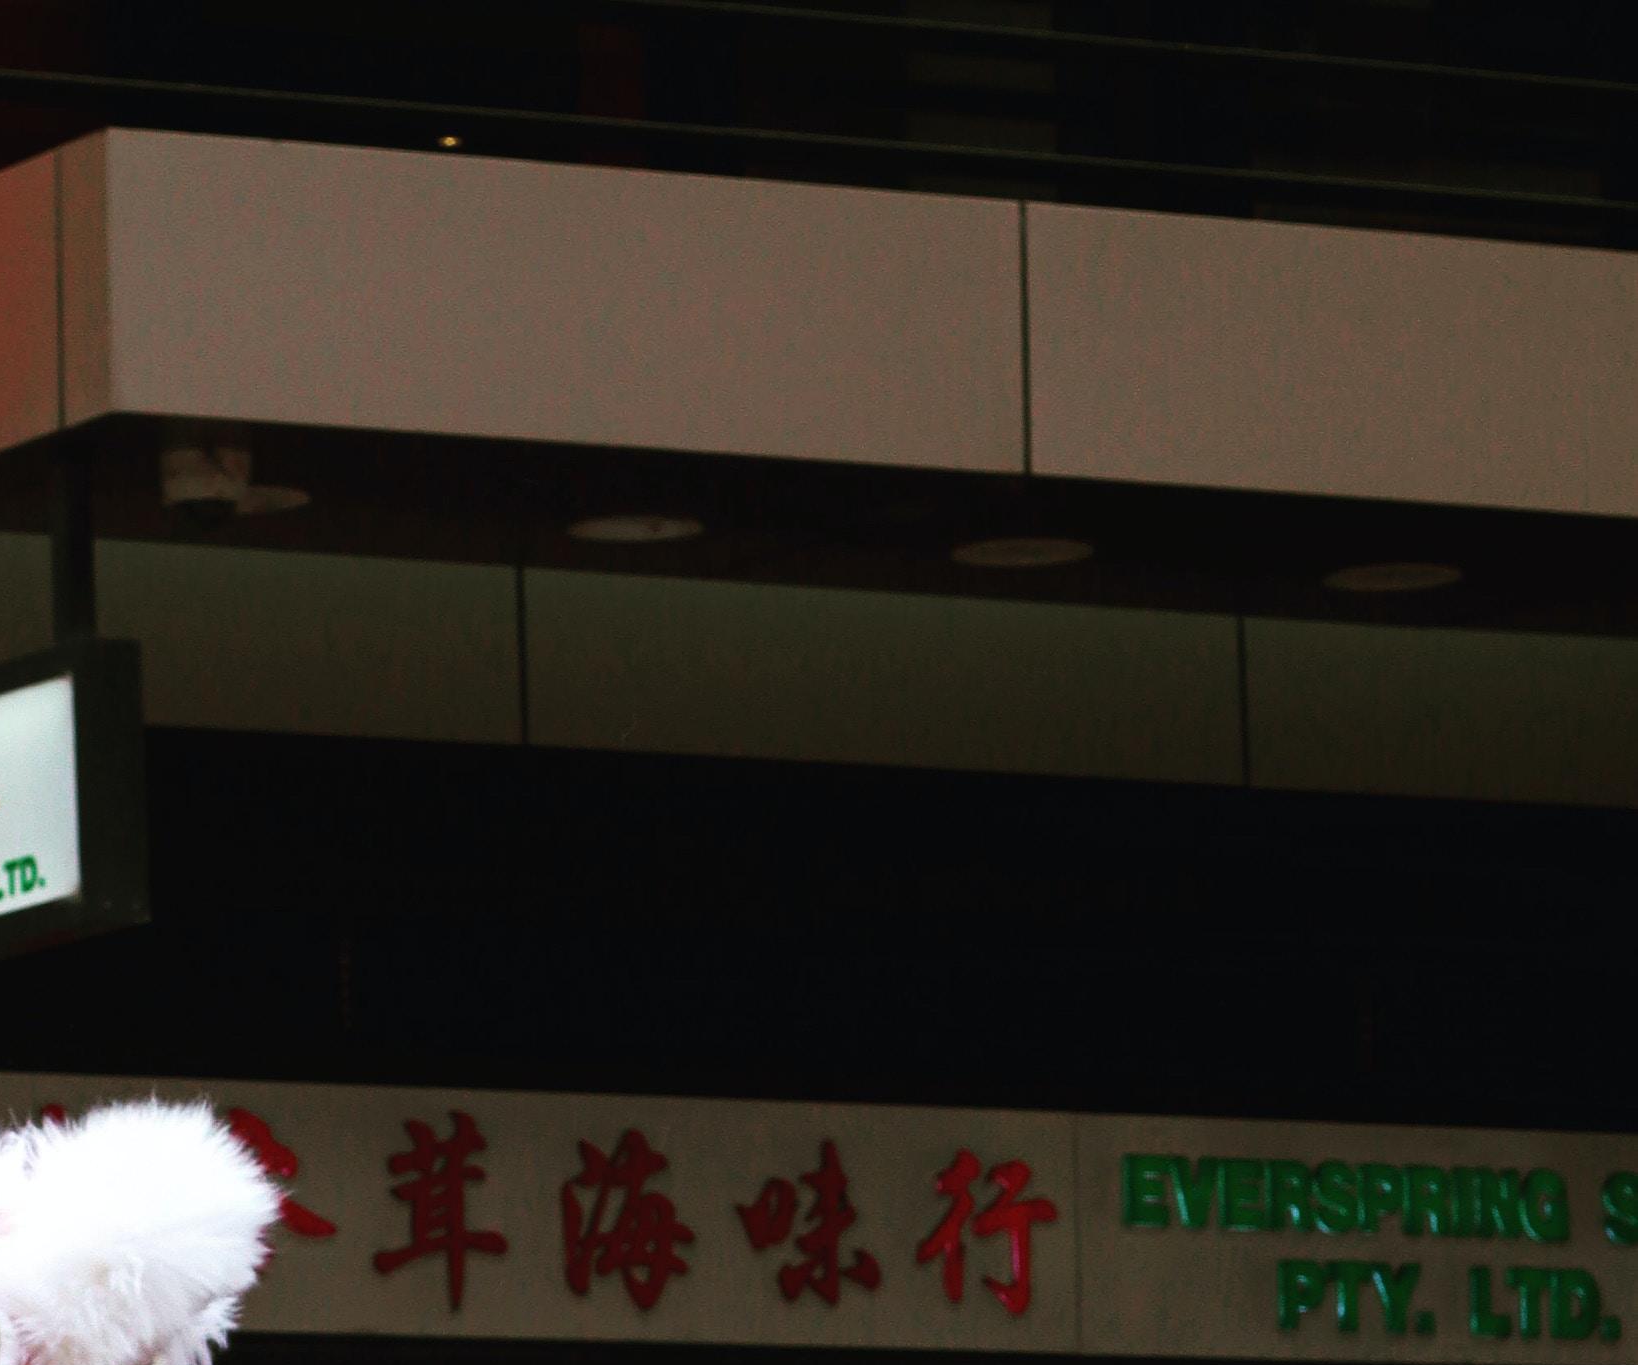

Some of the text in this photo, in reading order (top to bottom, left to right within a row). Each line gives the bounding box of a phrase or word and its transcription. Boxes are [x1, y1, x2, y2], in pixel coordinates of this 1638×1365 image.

[1121, 1153, 1571, 1244] EVERSPRING
[1276, 1258, 1623, 1345] PTY. LTD.
